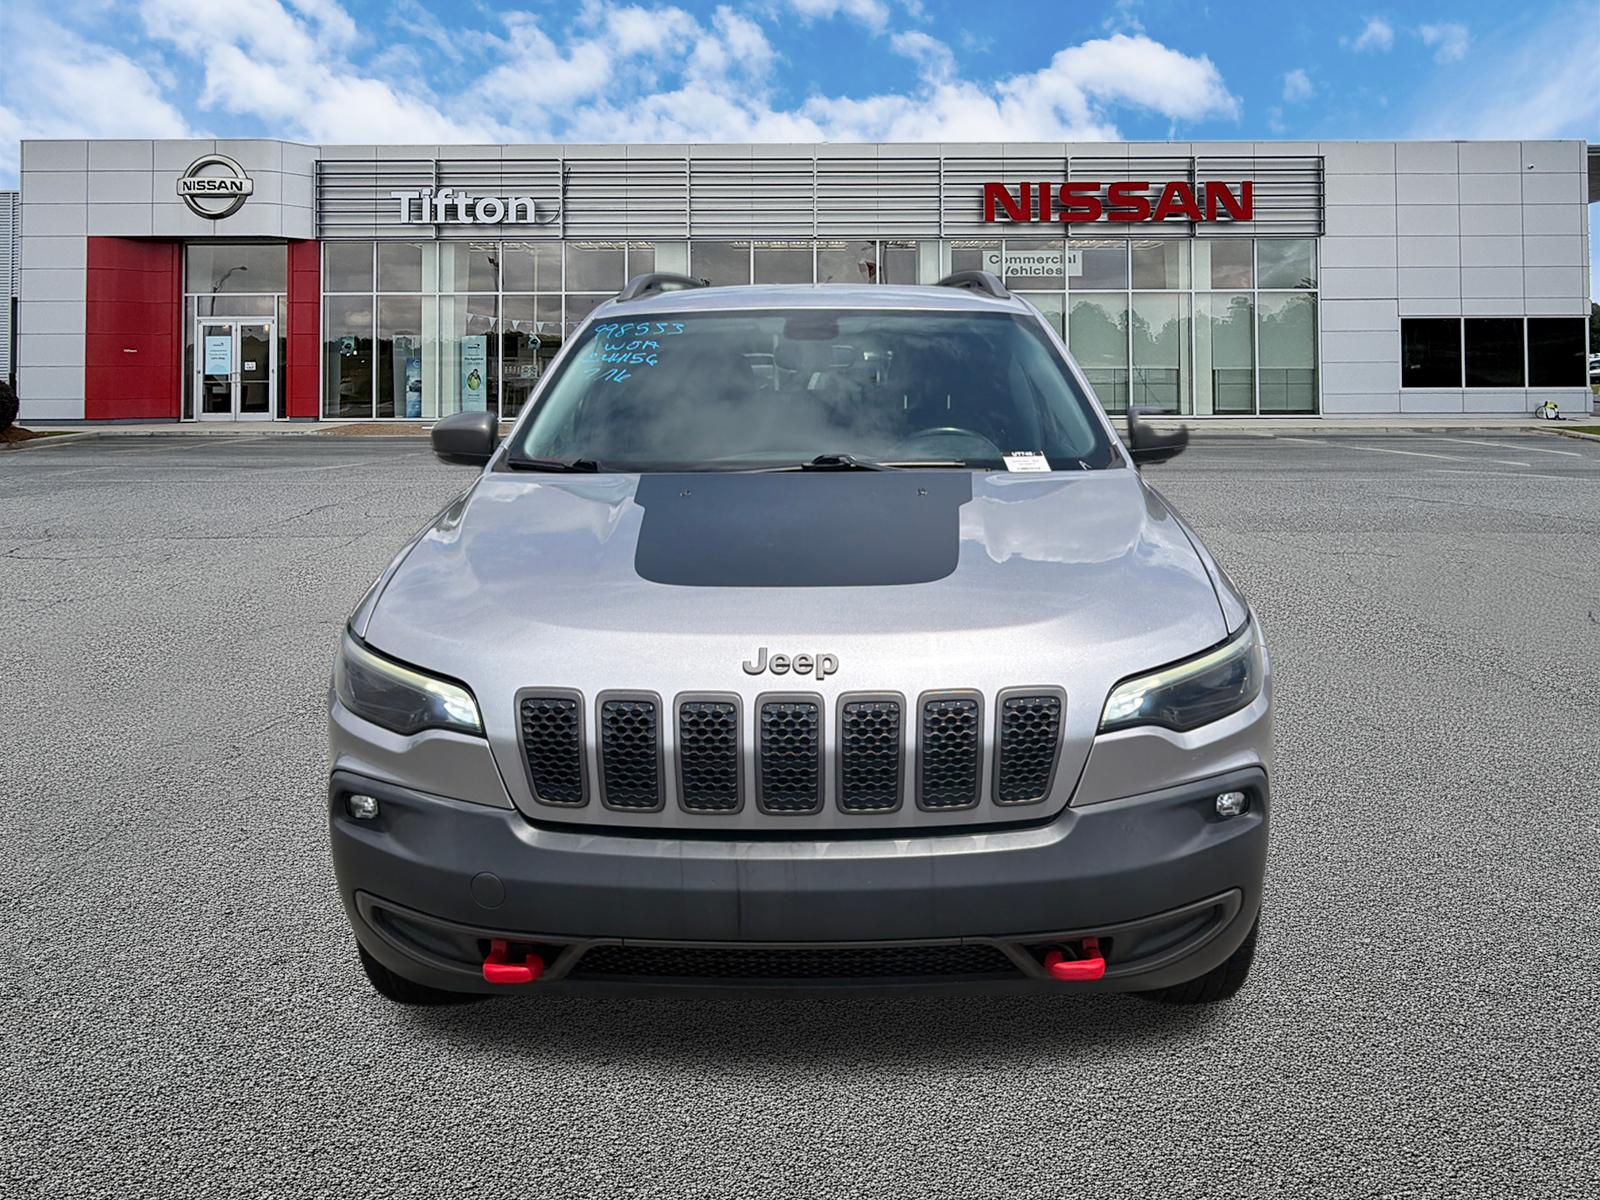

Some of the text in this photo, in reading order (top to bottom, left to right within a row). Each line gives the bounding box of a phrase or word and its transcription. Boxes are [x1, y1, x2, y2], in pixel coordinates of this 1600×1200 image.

[182, 180, 243, 191] NISSAN
[983, 181, 1254, 223] NISSAN
[391, 187, 537, 224] Tifton
[742, 647, 839, 681] Jeep
